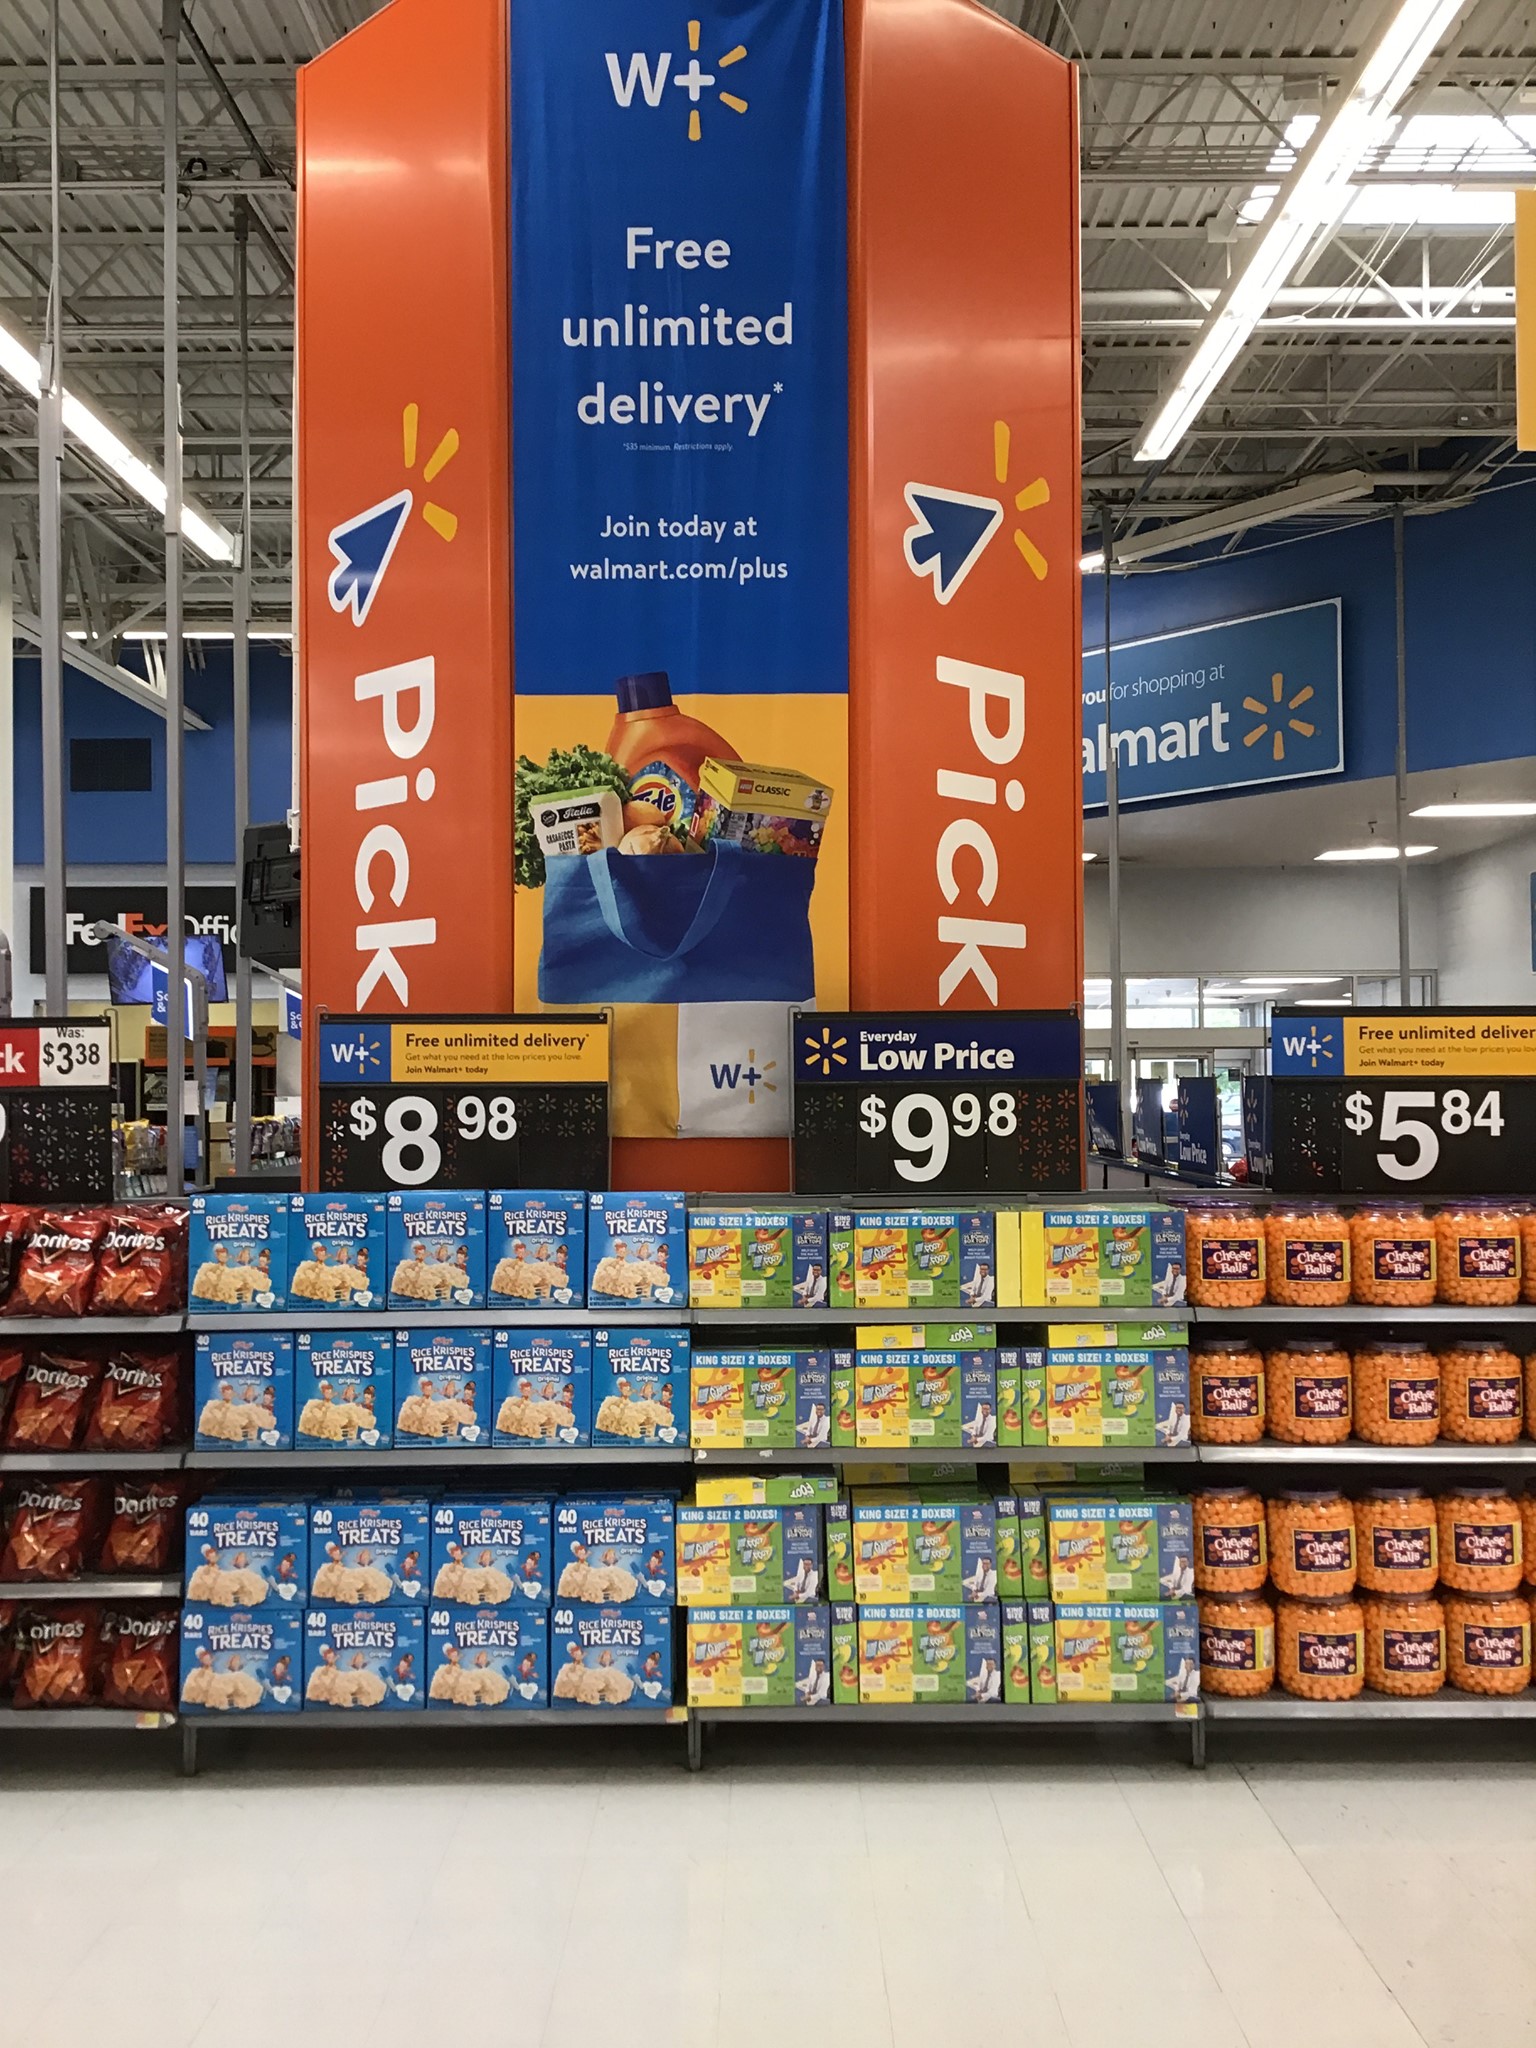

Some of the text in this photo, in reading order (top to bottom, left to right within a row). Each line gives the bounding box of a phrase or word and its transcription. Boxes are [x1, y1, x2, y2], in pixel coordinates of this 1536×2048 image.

[627, 227, 731, 269] Free
[562, 302, 793, 346] unlimited
[673, 443, 712, 451] Restrictions
[600, 514, 758, 543] Join today at
[569, 556, 788, 585] walmart.com/plus
[1110, 682, 1129, 701] for
[1132, 669, 1206, 696] shopping
[1209, 663, 1225, 680] at
[755, 784, 791, 796] CLASSIC
[633, 789, 676, 811] Tde
[563, 806, 594, 819] Italia
[354, 655, 436, 1011] Pick
[936, 655, 1026, 1007] Pick
[558, 840, 576, 851] PASTA
[56, 1027, 85, 1038] Was:
[860, 1031, 917, 1046] Everyday
[1359, 1026, 1394, 1040] Free
[1399, 1026, 1476, 1040] unlimited
[406, 1033, 439, 1048] Free
[445, 1033, 519, 1047] unlimited
[860, 1042, 1015, 1071] Low Price
[1359, 1046, 1374, 1054] Get
[1376, 1045, 1395, 1054] what
[1398, 1047, 1413, 1056] you
[1415, 1045, 1436, 1054] need
[1438, 1046, 1446, 1054] at
[1448, 1045, 1461, 1054] the
[1463, 1045, 1478, 1054] low
[1480, 1046, 1505, 1055] prices
[1507, 1046, 1522, 1054] you
[405, 1052, 420, 1061] Get
[423, 1052, 442, 1061] what
[444, 1053, 458, 1062] you
[461, 1052, 480, 1061] need
[482, 1053, 489, 1061] at
[491, 1052, 505, 1061] the
[506, 1052, 520, 1061] low
[522, 1053, 546, 1062] prices
[548, 1053, 562, 1062] you
[405, 1065, 422, 1074] Join
[465, 1065, 488, 1075] today
[1359, 1059, 1376, 1067] Join
[1421, 1059, 1445, 1069] today
[192, 1198, 205, 1209] 40
[291, 1196, 304, 1206] 40
[389, 1196, 402, 1206] 40
[489, 1195, 502, 1204] 40
[590, 1195, 603, 1204] 40
[206, 1213, 270, 1225] RICE KRISPIES
[304, 1212, 368, 1223] RICE KRISPIES
[403, 1210, 467, 1222] RICE KRISPIES
[504, 1209, 567, 1221] RICE KRISPIES
[605, 1209, 668, 1221] RICE KRISPIES
[694, 1216, 788, 1226] KING SIZE! 2 BOXES!
[860, 1216, 954, 1226] KING SIZE! 2 BOXES!
[1050, 1214, 1146, 1225] KING SIZE! 2 BOXES!
[208, 1224, 268, 1239] TREATS
[306, 1222, 366, 1237] TREATS
[405, 1220, 466, 1235] TREATS
[506, 1219, 566, 1235] TREATS
[607, 1219, 666, 1235] TREATS
[1213, 1250, 1252, 1263] Cheese
[1297, 1251, 1336, 1264] Cheese
[1385, 1250, 1424, 1263] Cheese
[1470, 1248, 1509, 1261] Cheese
[1220, 1262, 1248, 1274] Balls
[1305, 1263, 1332, 1275] Balls
[1393, 1263, 1421, 1274] Balls
[1478, 1260, 1506, 1272] Balls
[554, 1610, 573, 1625] 40
[694, 1610, 790, 1620] KING SIZE! 2 BOXES!
[578, 1619, 643, 1631] RICE KRISPIES
[580, 1630, 641, 1645] TREATS
[1475, 1637, 1516, 1650] Cheese
[1484, 1649, 1511, 1661] Balls
